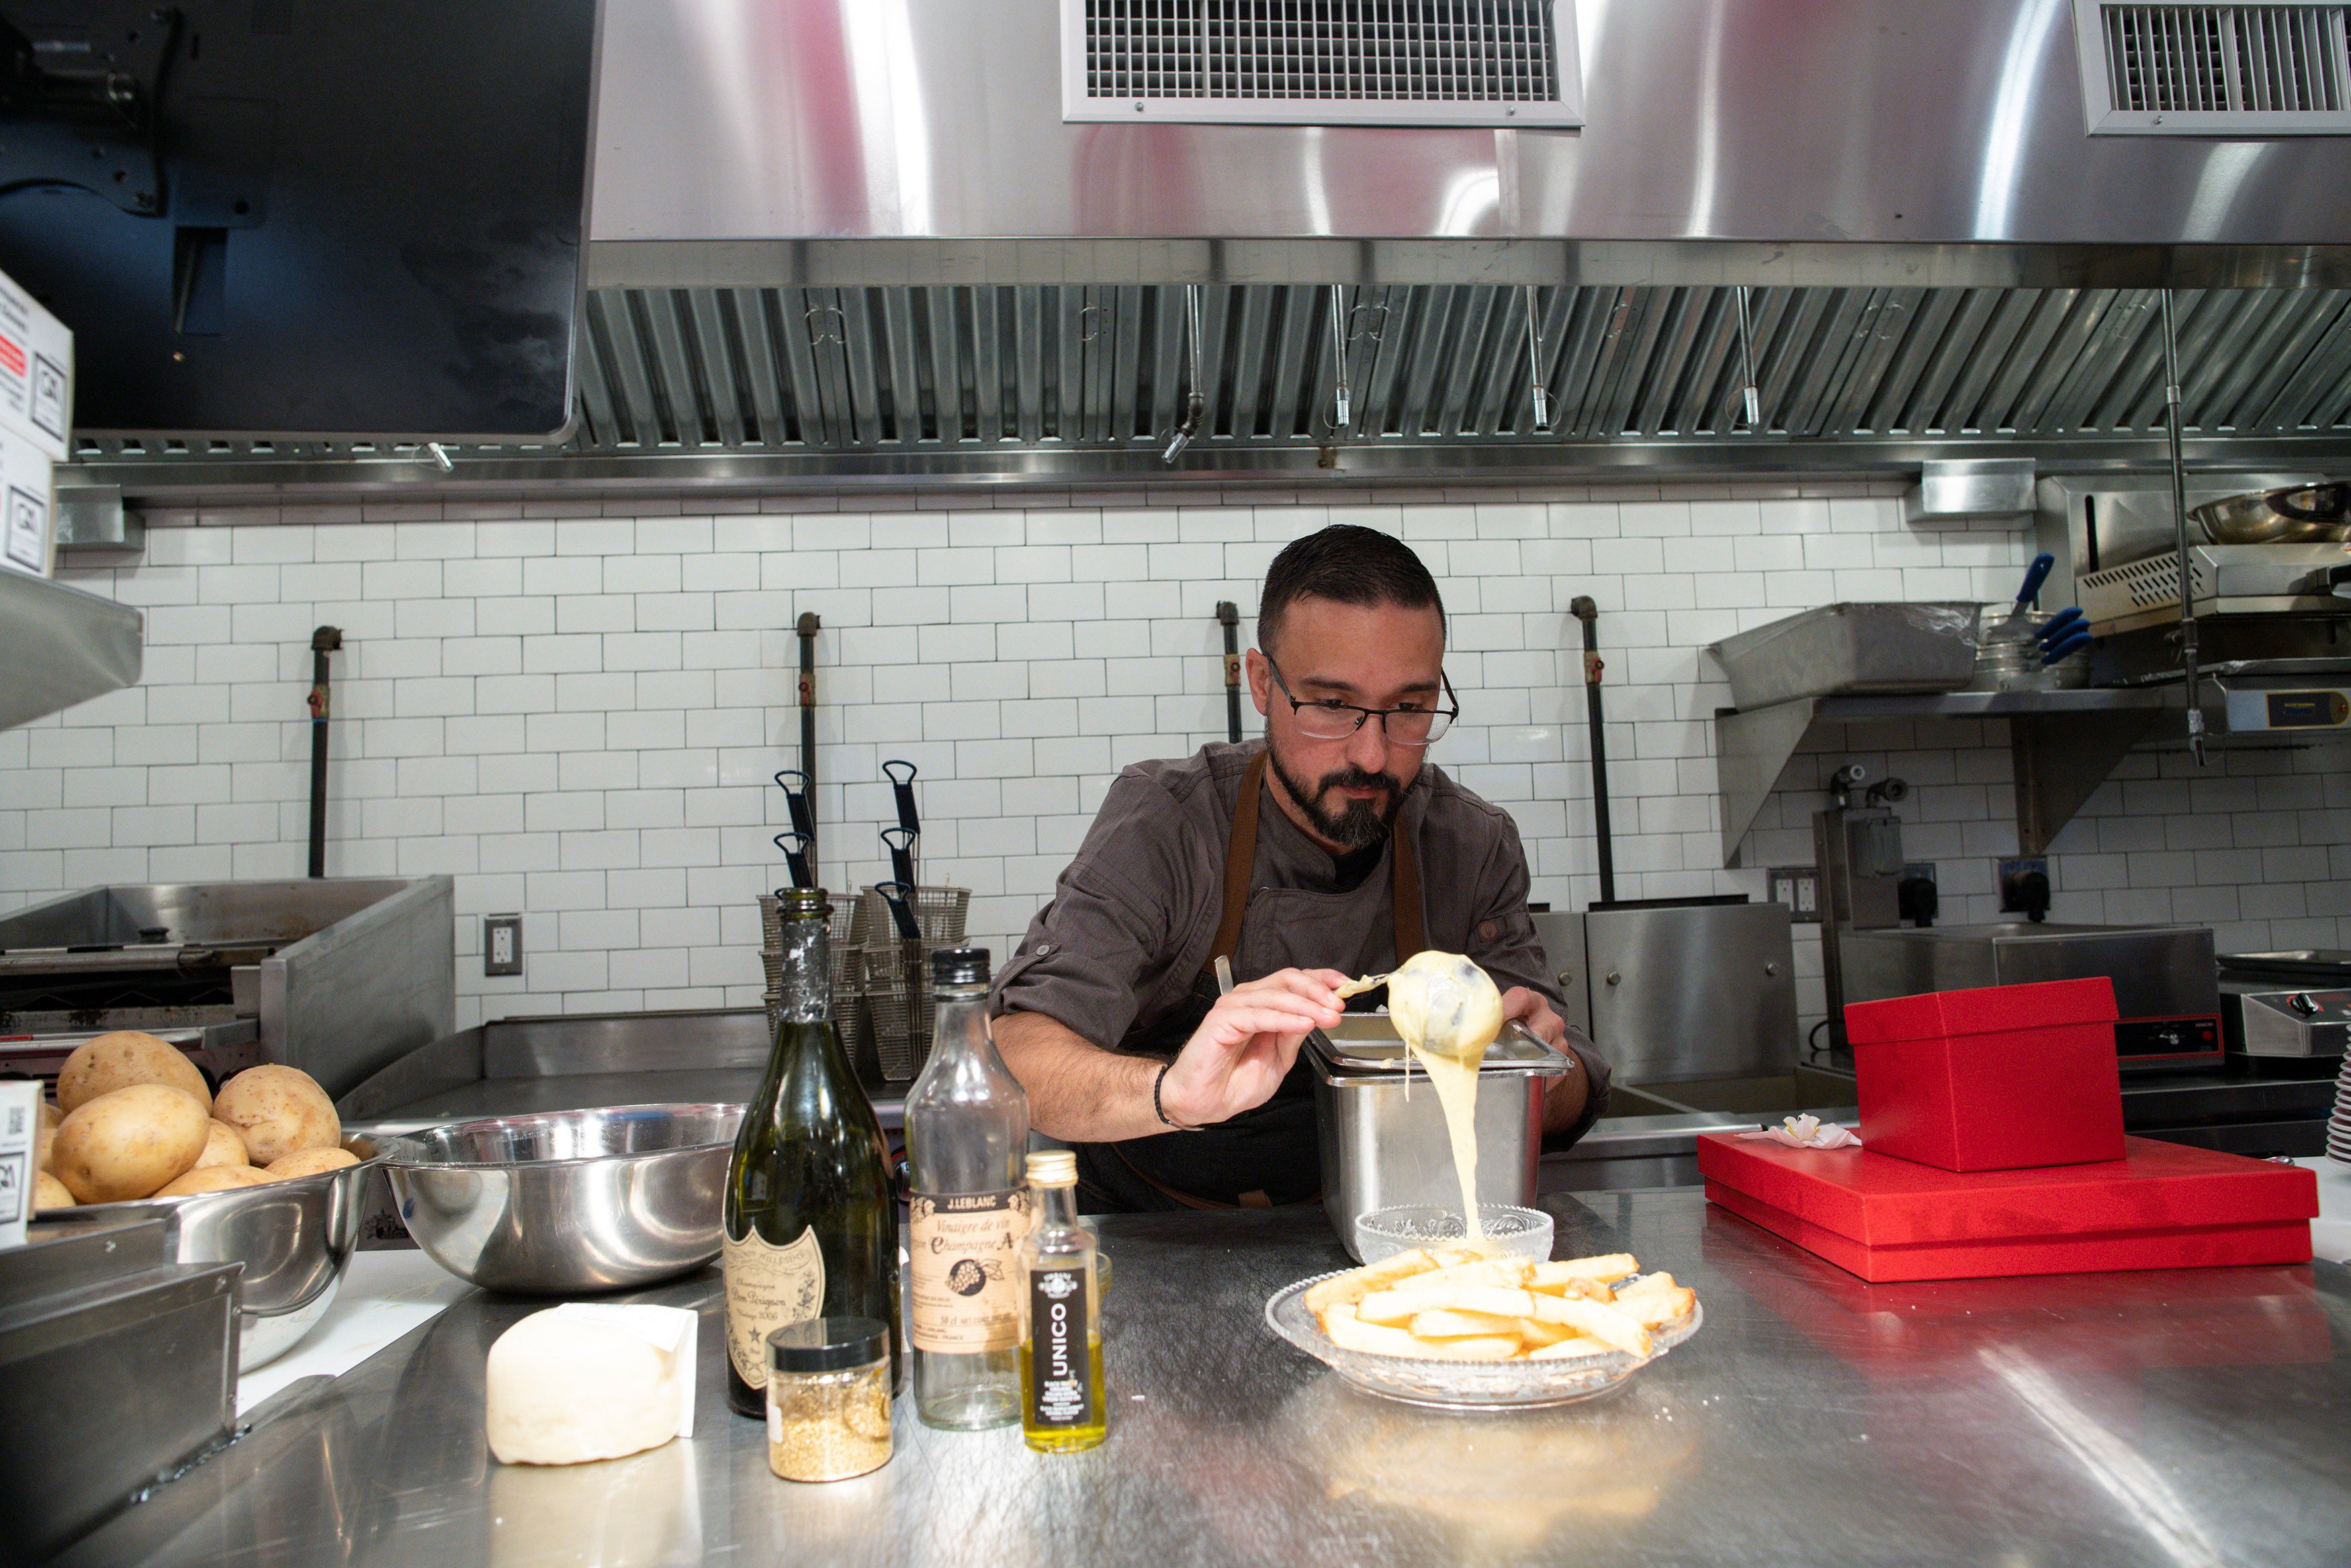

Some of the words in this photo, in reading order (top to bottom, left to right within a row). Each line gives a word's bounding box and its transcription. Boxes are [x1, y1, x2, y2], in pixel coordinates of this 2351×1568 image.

[947, 1195, 996, 1209] J.LEBLANC
[937, 1219, 978, 1234] Vinaigre
[981, 1218, 991, 1232] de
[996, 1218, 1010, 1230] vin
[932, 1236, 995, 1254] Champagne
[731, 1287, 747, 1303] Dom
[1051, 1303, 1068, 1377] UNICO
